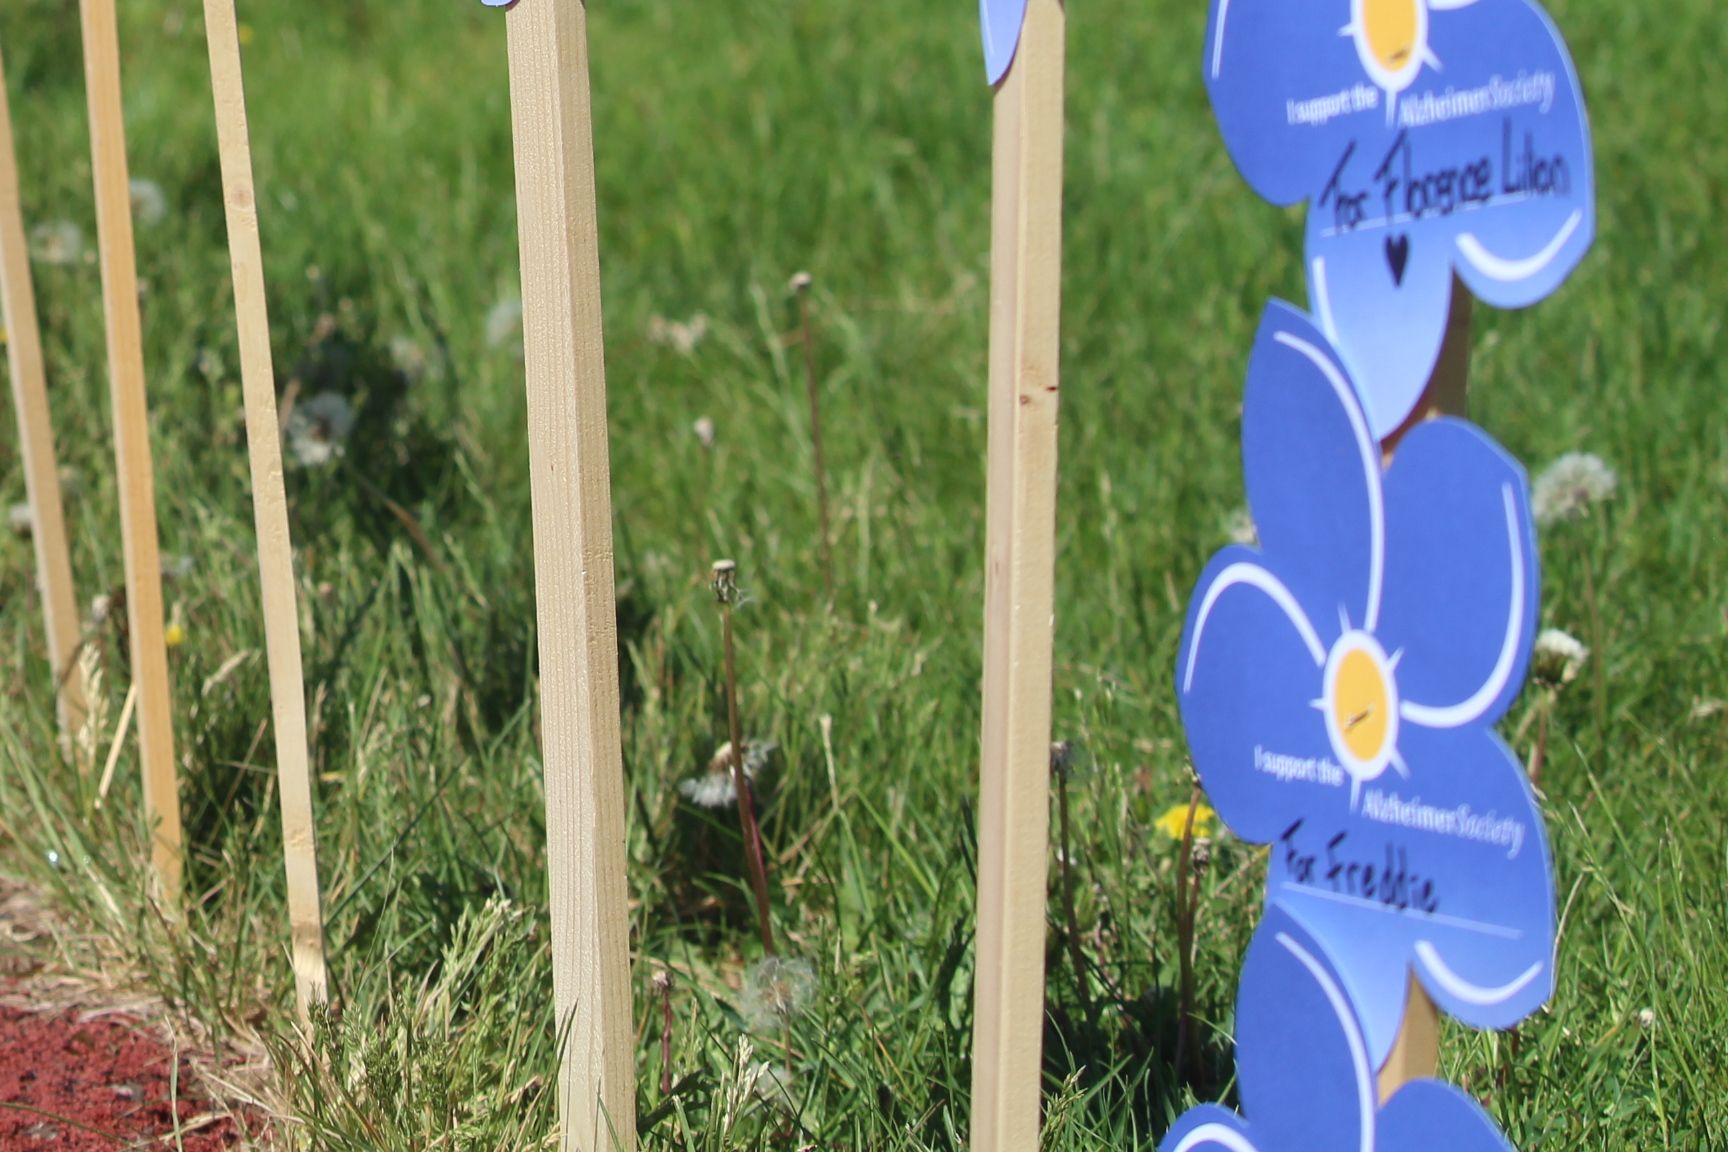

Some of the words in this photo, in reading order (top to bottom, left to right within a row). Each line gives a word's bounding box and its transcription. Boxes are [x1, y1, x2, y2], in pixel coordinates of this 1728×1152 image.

[1294, 87, 1351, 127] support
[1350, 80, 1379, 113] the
[1318, 140, 1370, 235] For
[1262, 750, 1317, 784] support
[1317, 754, 1345, 787] the
[1280, 817, 1316, 884] For
[1325, 829, 1441, 915] Freddie
